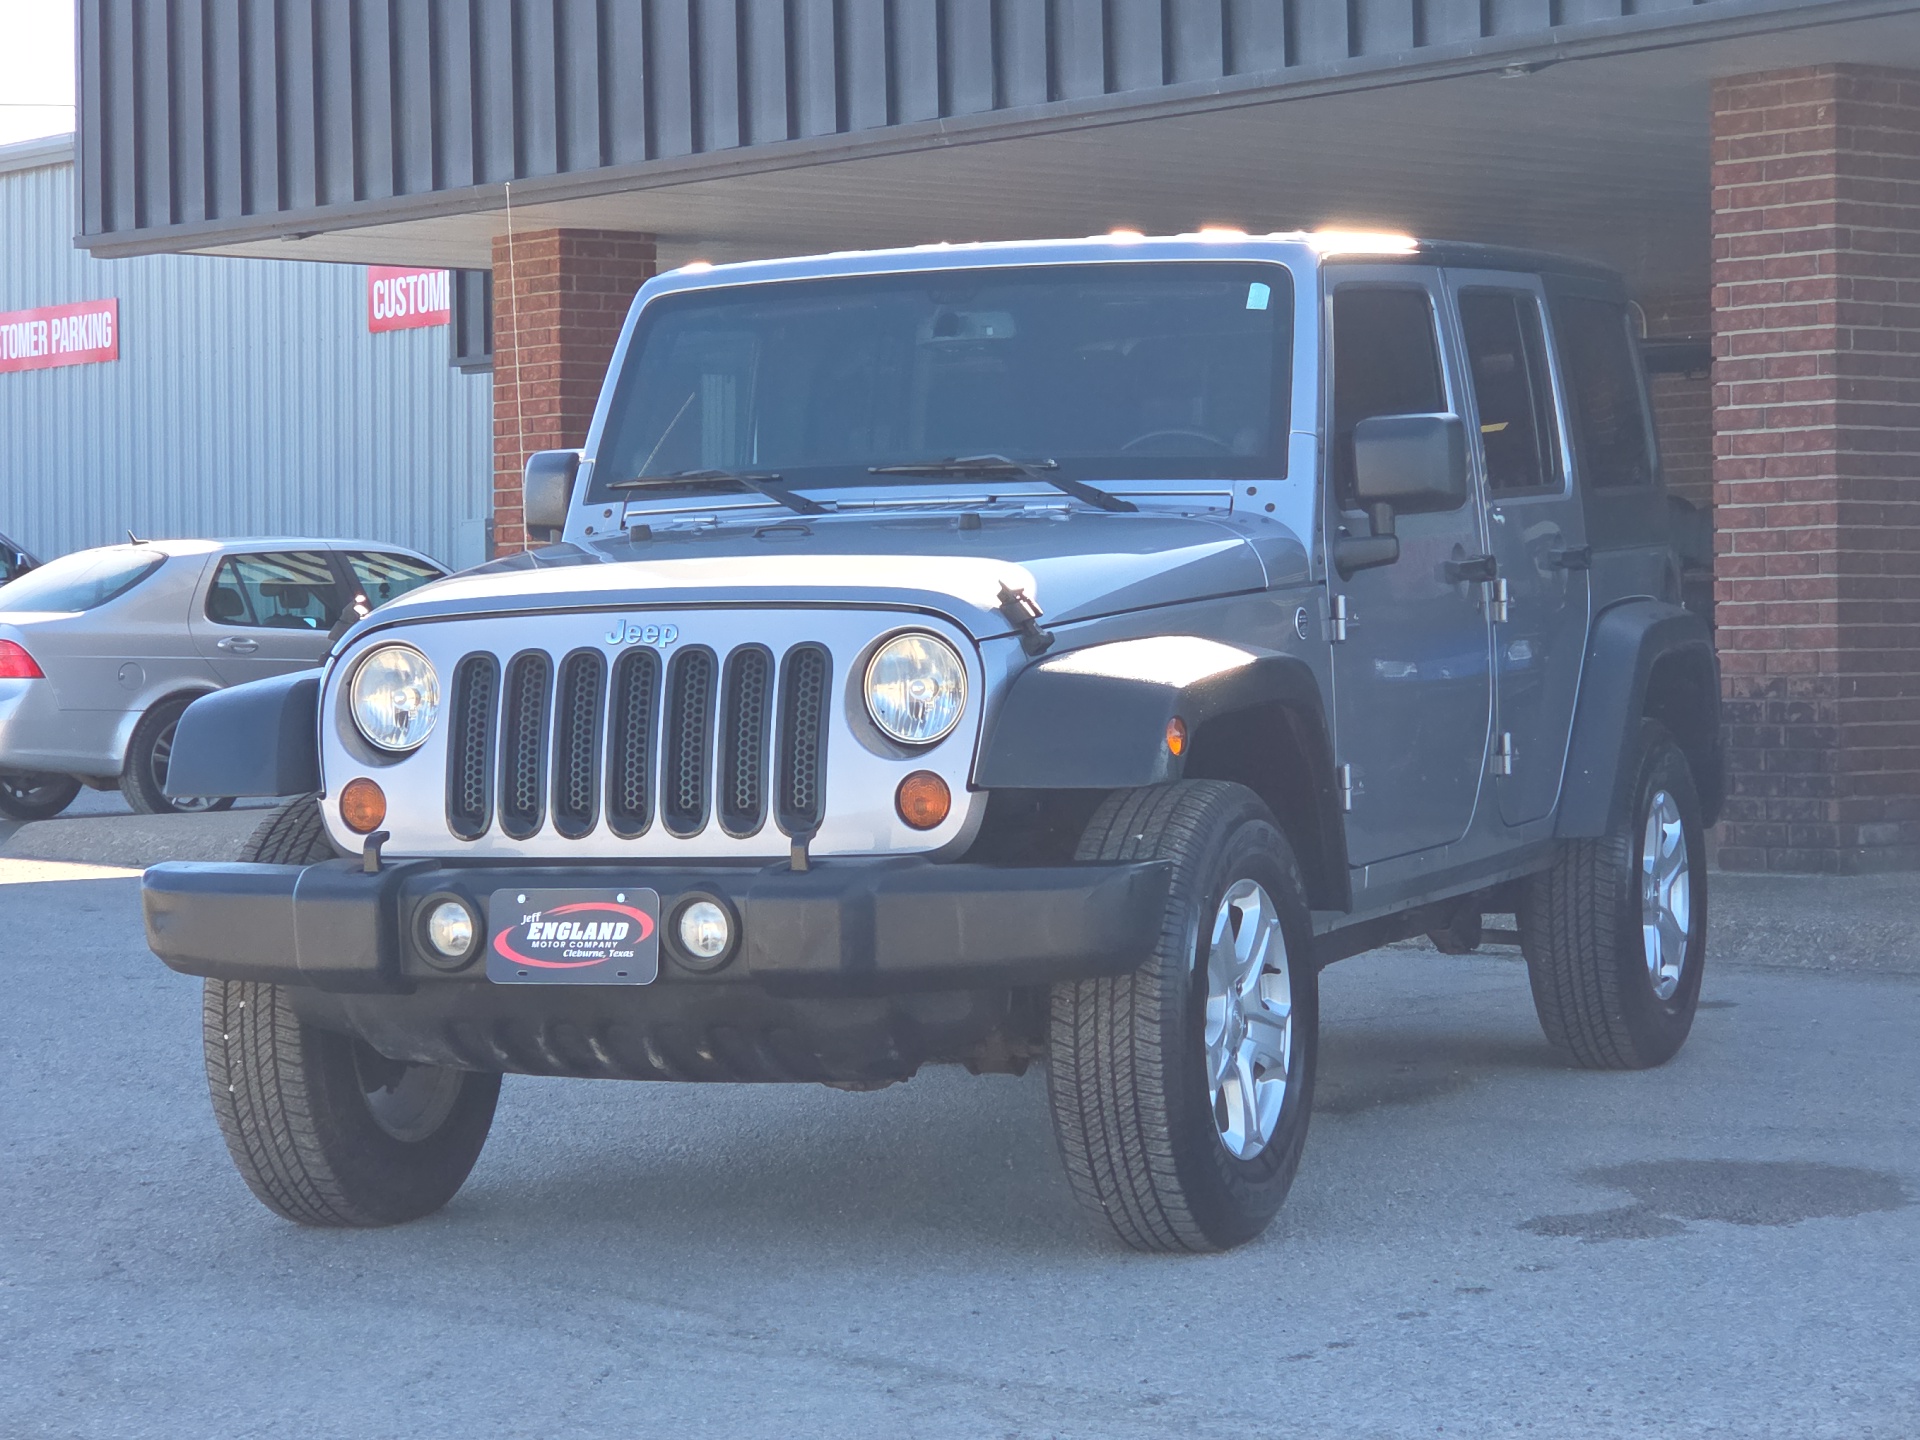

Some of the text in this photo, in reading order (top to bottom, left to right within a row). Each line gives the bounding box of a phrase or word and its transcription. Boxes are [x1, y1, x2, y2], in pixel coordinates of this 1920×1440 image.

[0, 311, 112, 360] TOMER PARKING
[605, 619, 679, 648] Jeep
[520, 911, 542, 925] Jeff
[526, 922, 629, 941] ENGLAND
[531, 940, 566, 948] MOTOR
[562, 949, 635, 958] Cleburne, Texas
